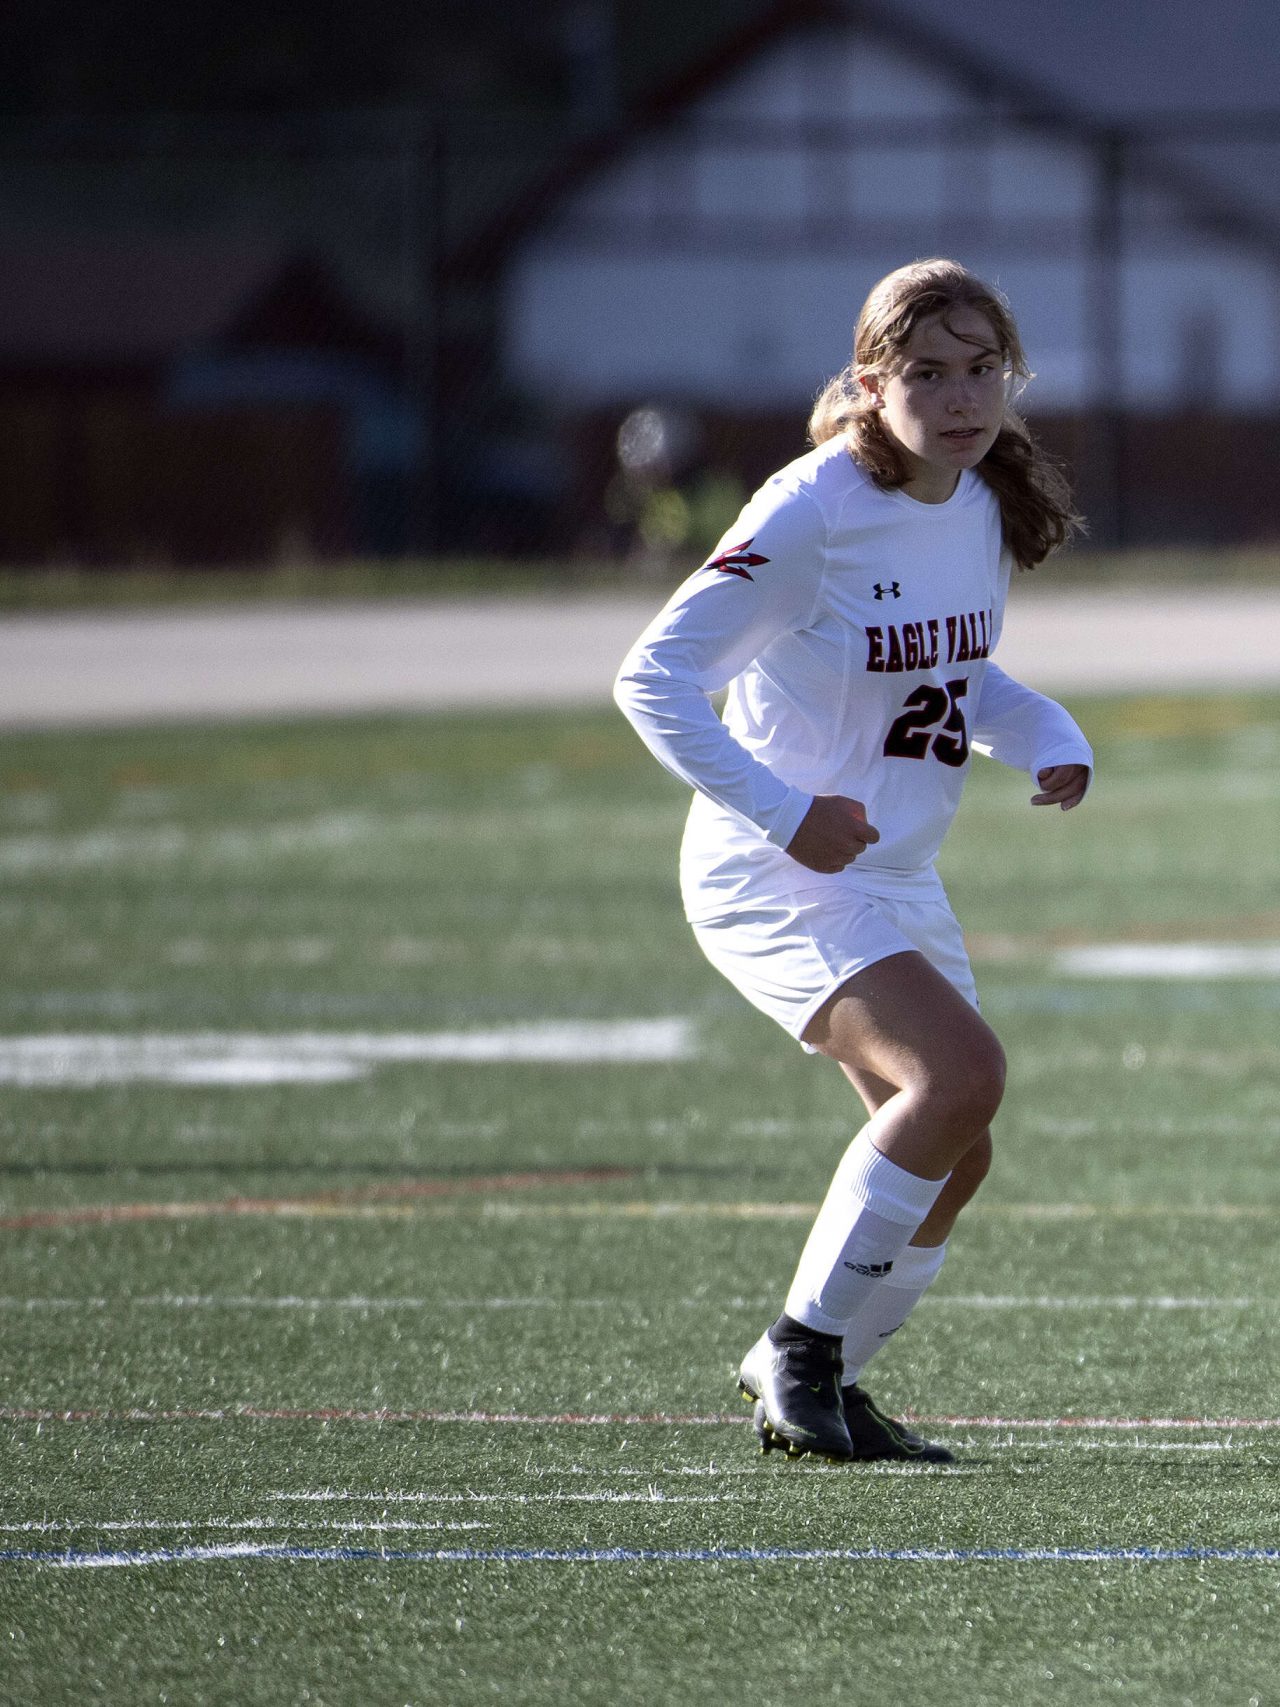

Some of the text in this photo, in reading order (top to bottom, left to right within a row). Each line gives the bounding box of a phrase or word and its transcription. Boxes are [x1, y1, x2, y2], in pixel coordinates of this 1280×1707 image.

[865, 609, 993, 673] EAGLE VALL
[883, 676, 969, 768] 25
